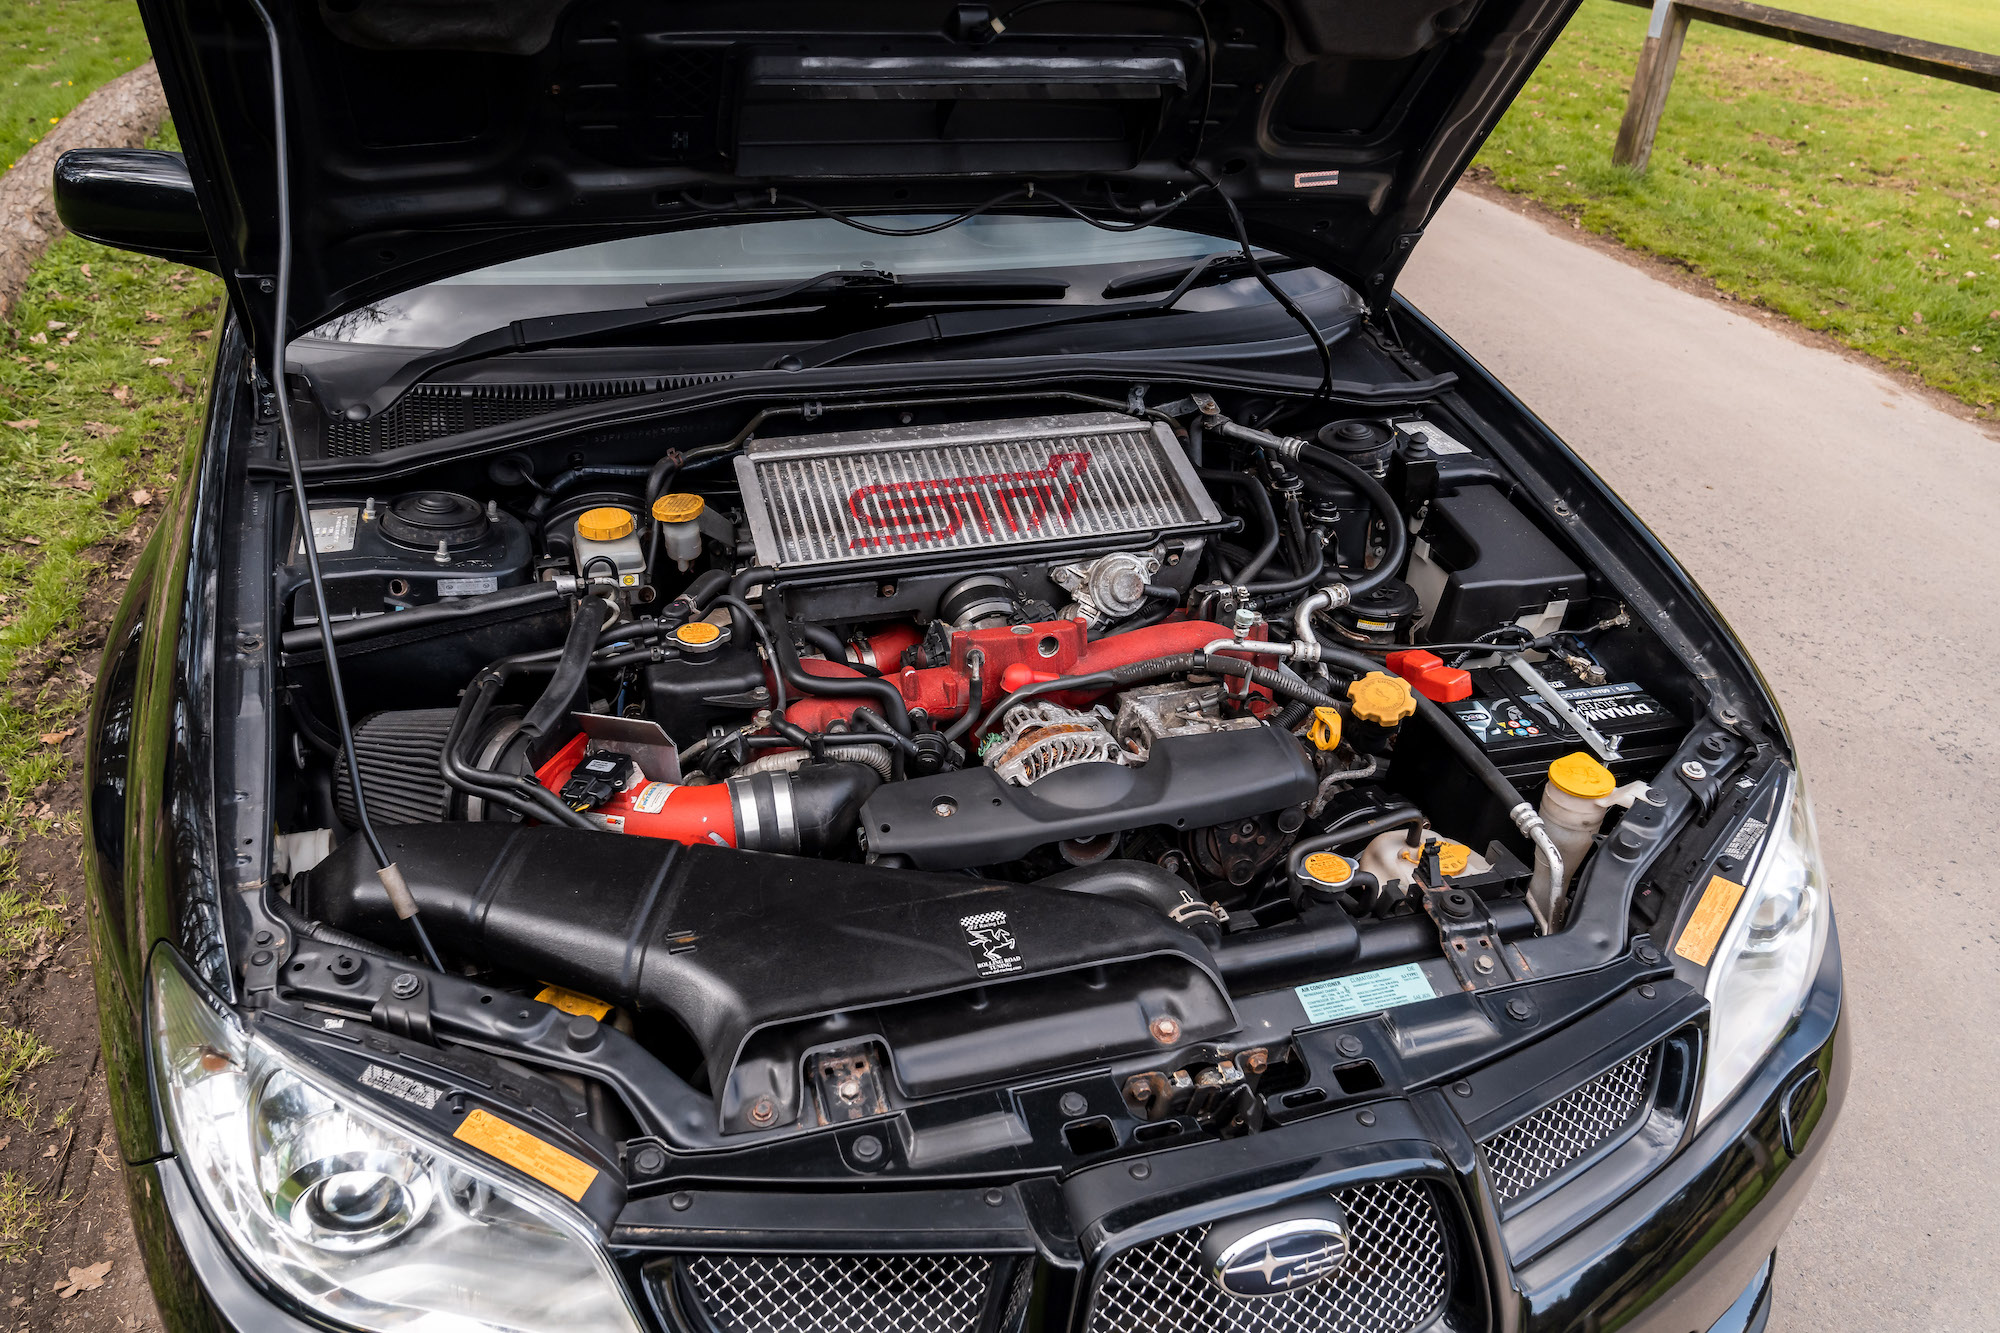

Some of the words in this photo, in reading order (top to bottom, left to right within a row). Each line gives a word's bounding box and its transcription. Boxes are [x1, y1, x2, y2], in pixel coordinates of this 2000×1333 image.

[1580, 700, 1618, 711] SILVER
[1577, 702, 1654, 722] DYNAM
[977, 959, 1003, 969] ROLLING
[1310, 981, 1341, 991] CONDITIONER
